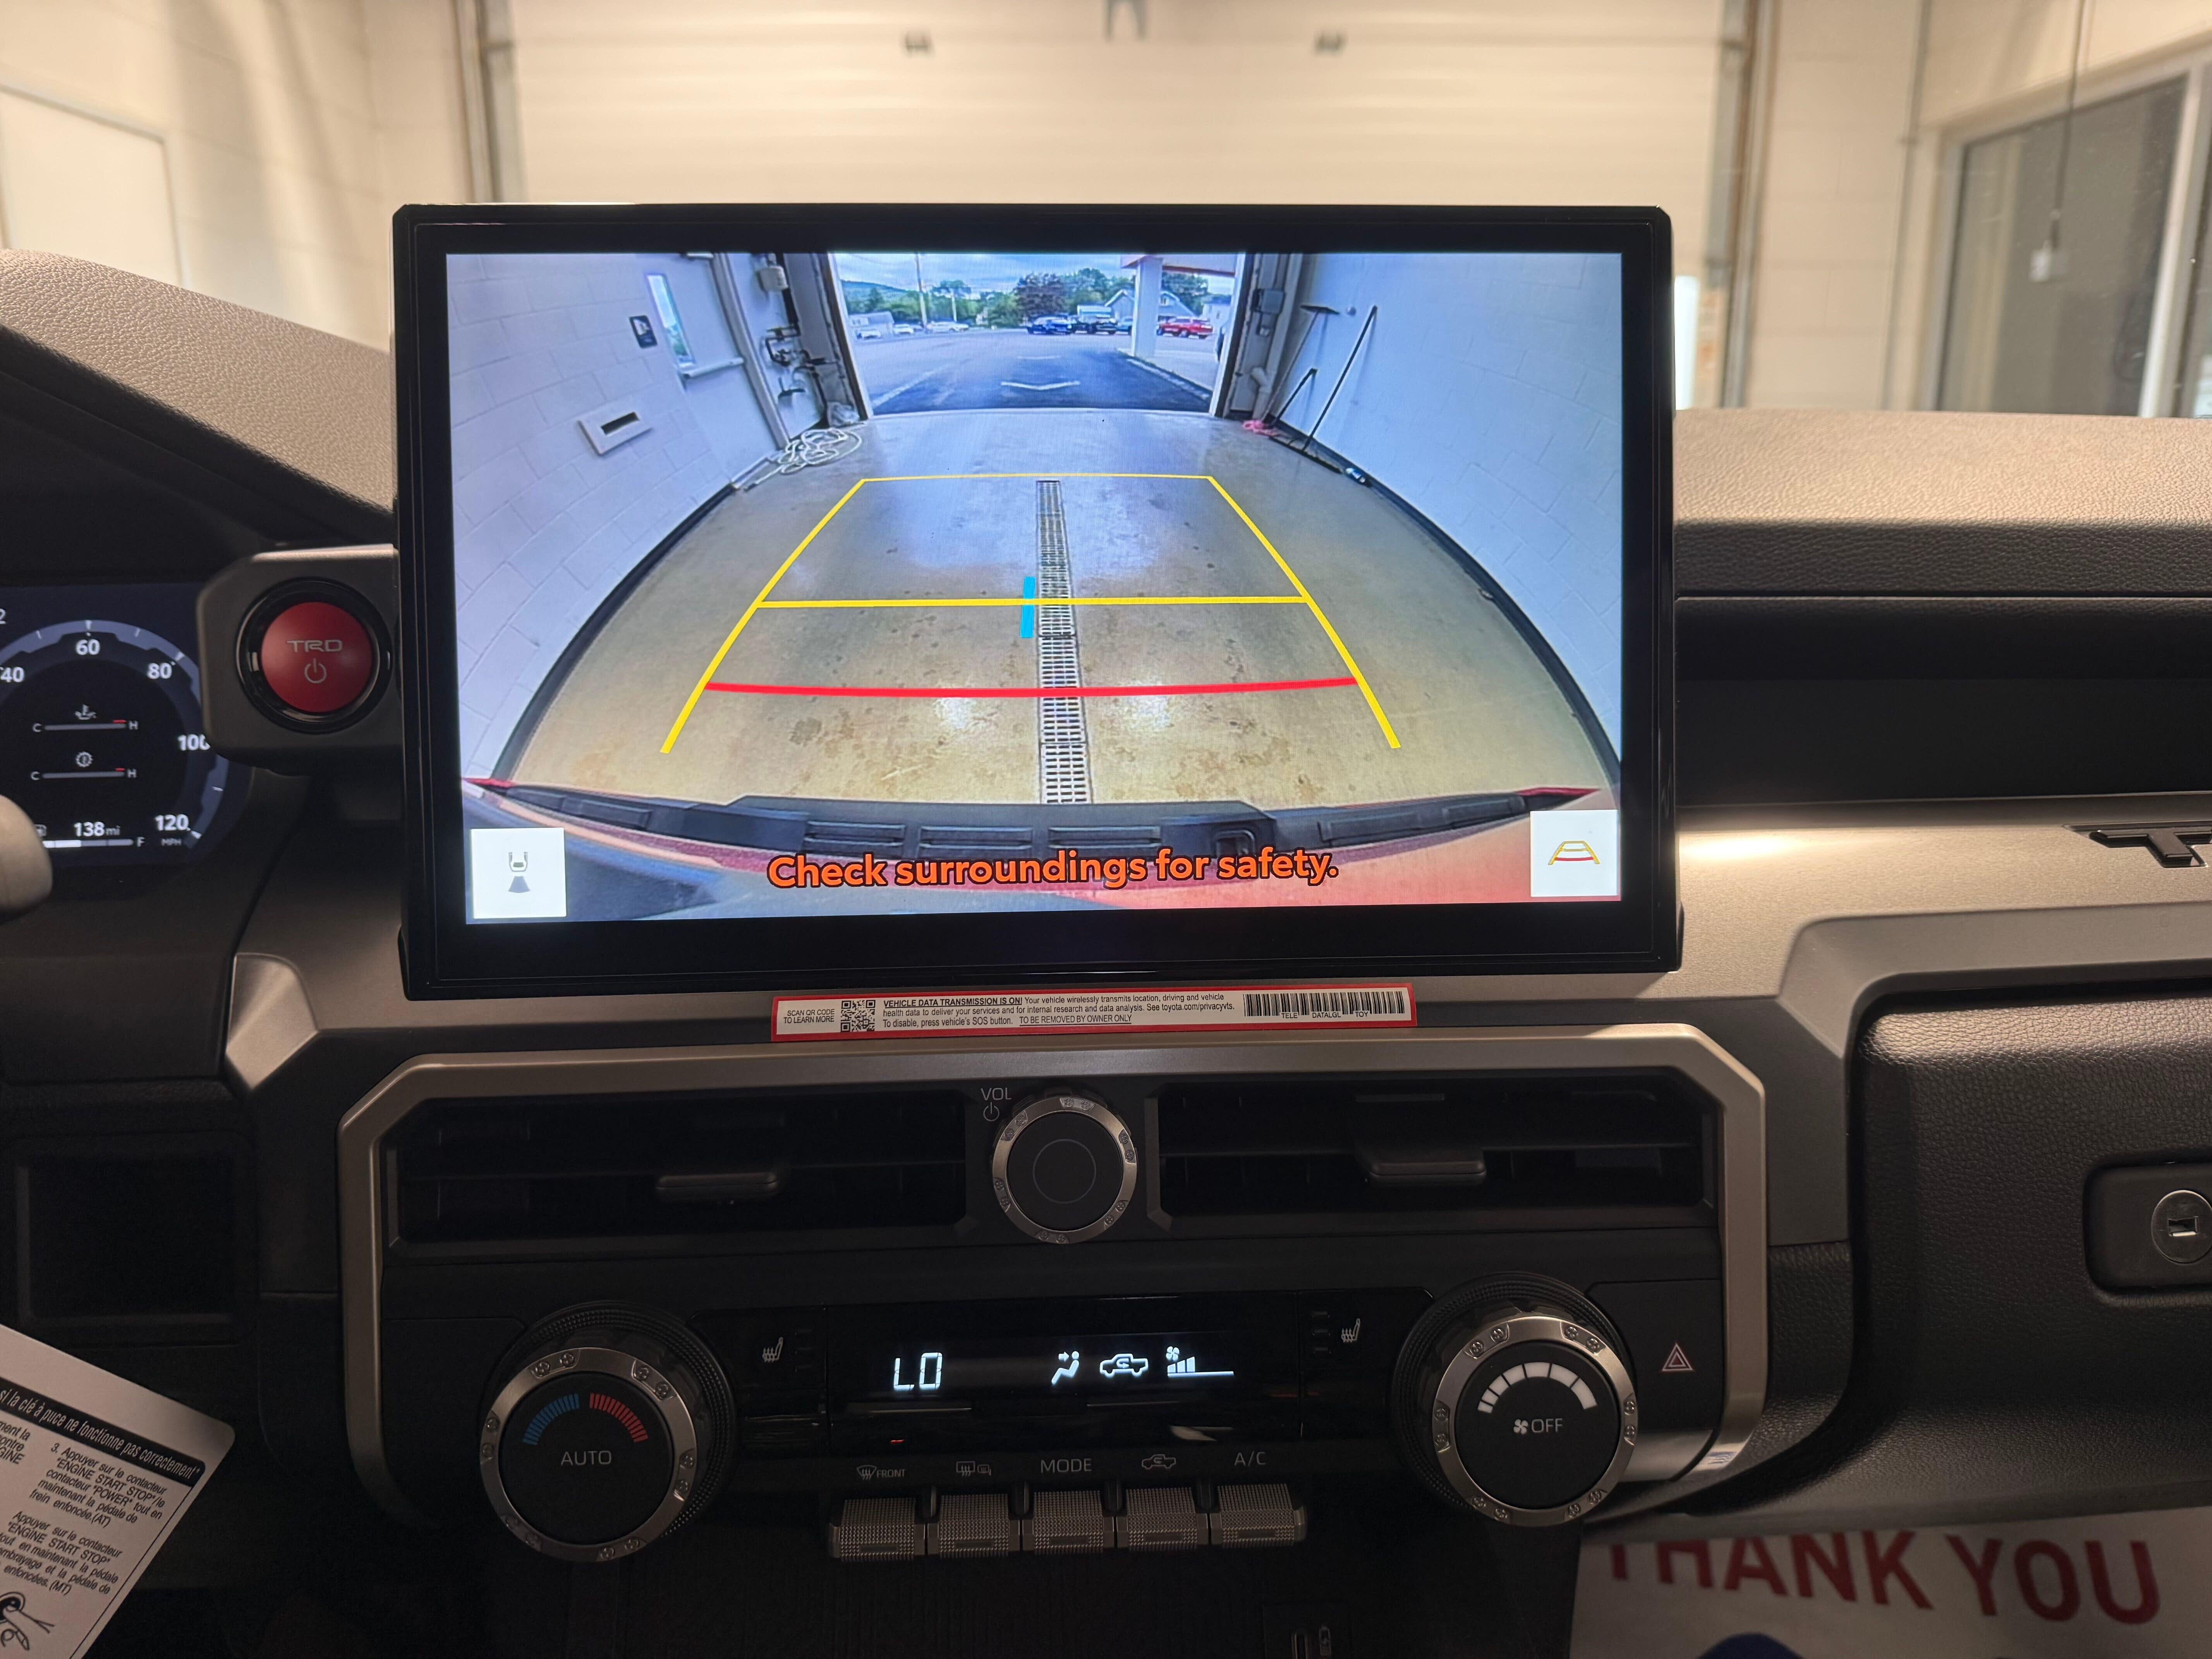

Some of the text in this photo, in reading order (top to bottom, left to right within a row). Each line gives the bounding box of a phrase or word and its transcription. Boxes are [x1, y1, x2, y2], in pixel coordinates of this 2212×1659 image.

[76, 639, 100, 655] 60
[287, 640, 342, 652] TRD
[0, 666, 25, 682] 40
[147, 663, 172, 679] 80
[33, 723, 41, 732] C
[129, 721, 138, 730] H
[31, 771, 40, 780] C
[127, 769, 137, 778] H
[155, 815, 189, 831] 120
[137, 837, 145, 847] F
[161, 838, 182, 846] MPH
[768, 846, 1338, 888] Check surroundings for safety.
[940, 997, 998, 1006] TRANSMISSION
[1067, 996, 1099, 1004] wirelessly
[1163, 994, 1184, 1002] driving
[1116, 1004, 1144, 1013] analysis.
[1162, 1002, 1234, 1012] toyota.com/privacyvts.
[883, 1019, 891, 1027] To
[893, 1019, 919, 1027] disable,
[921, 1020, 939, 1028] press
[972, 1017, 988, 1025] SOS
[990, 1017, 1013, 1025] button.
[981, 1087, 1012, 1100] VOL
[0, 1389, 12, 1403] si
[7, 1391, 20, 1407] la
[18, 1398, 40, 1413] clé
[34, 1402, 45, 1417] à
[39, 1409, 67, 1427] puce
[64, 1418, 79, 1432] ne
[1532, 1419, 1563, 1433] OFF
[19, 1429, 31, 1441] la
[77, 1420, 124, 1450] fonctionne
[0, 1435, 24, 1452] ontre
[120, 1442, 141, 1457] pas
[561, 1450, 612, 1466] AUTO
[1041, 1458, 1092, 1473] MODE
[1234, 1451, 1266, 1467] A/C
[51, 1443, 168, 1495] 3. Appuyer sur le contacteur
[876, 1469, 905, 1478] FRONT
[95, 1474, 127, 1492] START
[29, 1489, 51, 1504] frein
[38, 1480, 137, 1523] maintenant la pédale de
[46, 1469, 91, 1491] contacteur
[133, 1502, 151, 1515] tout
[151, 1510, 163, 1519] en
[12, 1511, 123, 1558] Appuyer sur le contacteur
[48, 1538, 81, 1555] START
[19, 1542, 31, 1552] en
[31, 1547, 78, 1568] maintenant
[79, 1562, 89, 1573] la
[45, 1565, 56, 1575] et
[57, 1568, 67, 1579] la
[99, 1584, 111, 1594] de
[1945, 1534, 2160, 1624] YOU
[49, 1580, 72, 1596] (MT)
